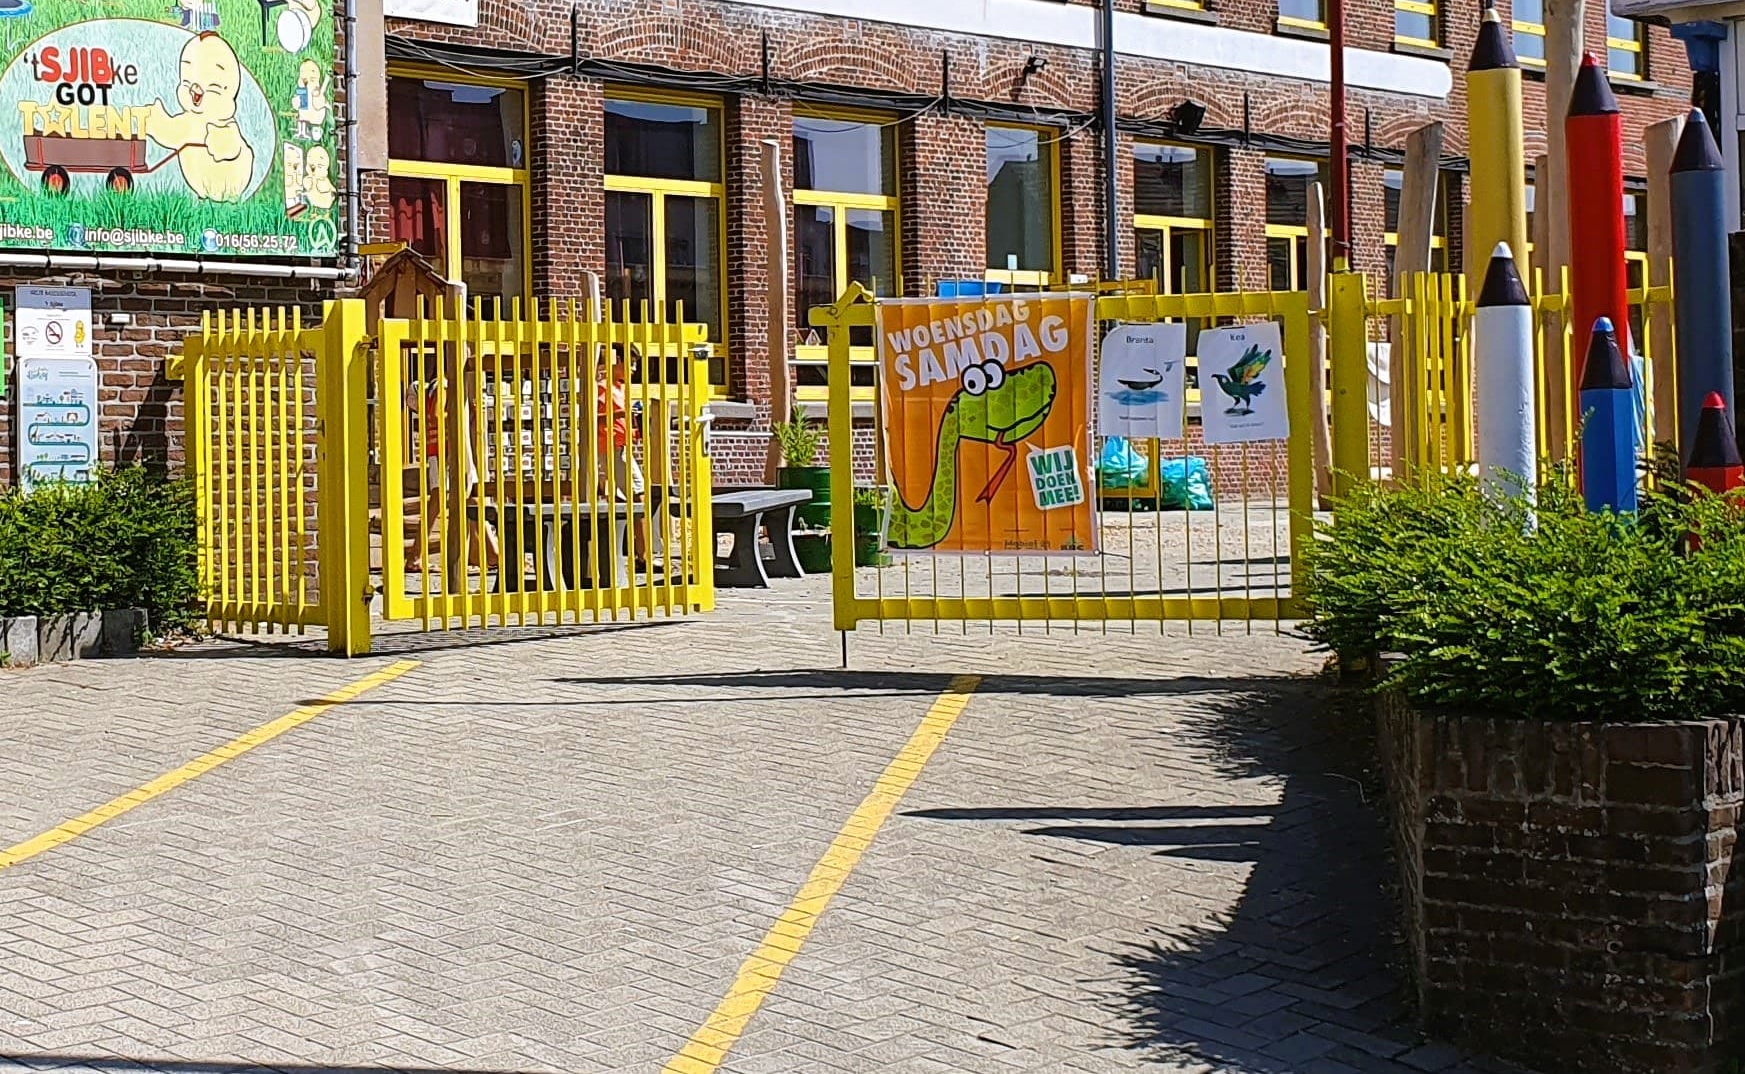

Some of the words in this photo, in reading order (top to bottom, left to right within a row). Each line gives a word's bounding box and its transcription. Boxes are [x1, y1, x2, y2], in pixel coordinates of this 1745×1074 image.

[55, 82, 113, 106] GOT
[84, 228, 184, 246] info@sjibke.be
[215, 233, 298, 250] 016/56.25.72
[887, 299, 1030, 354] WOENSDAG
[894, 315, 1069, 391] SAMDAG
[1030, 449, 1074, 476] WIJ
[1035, 470, 1077, 491] DOEN
[1038, 484, 1081, 507] MEE!
